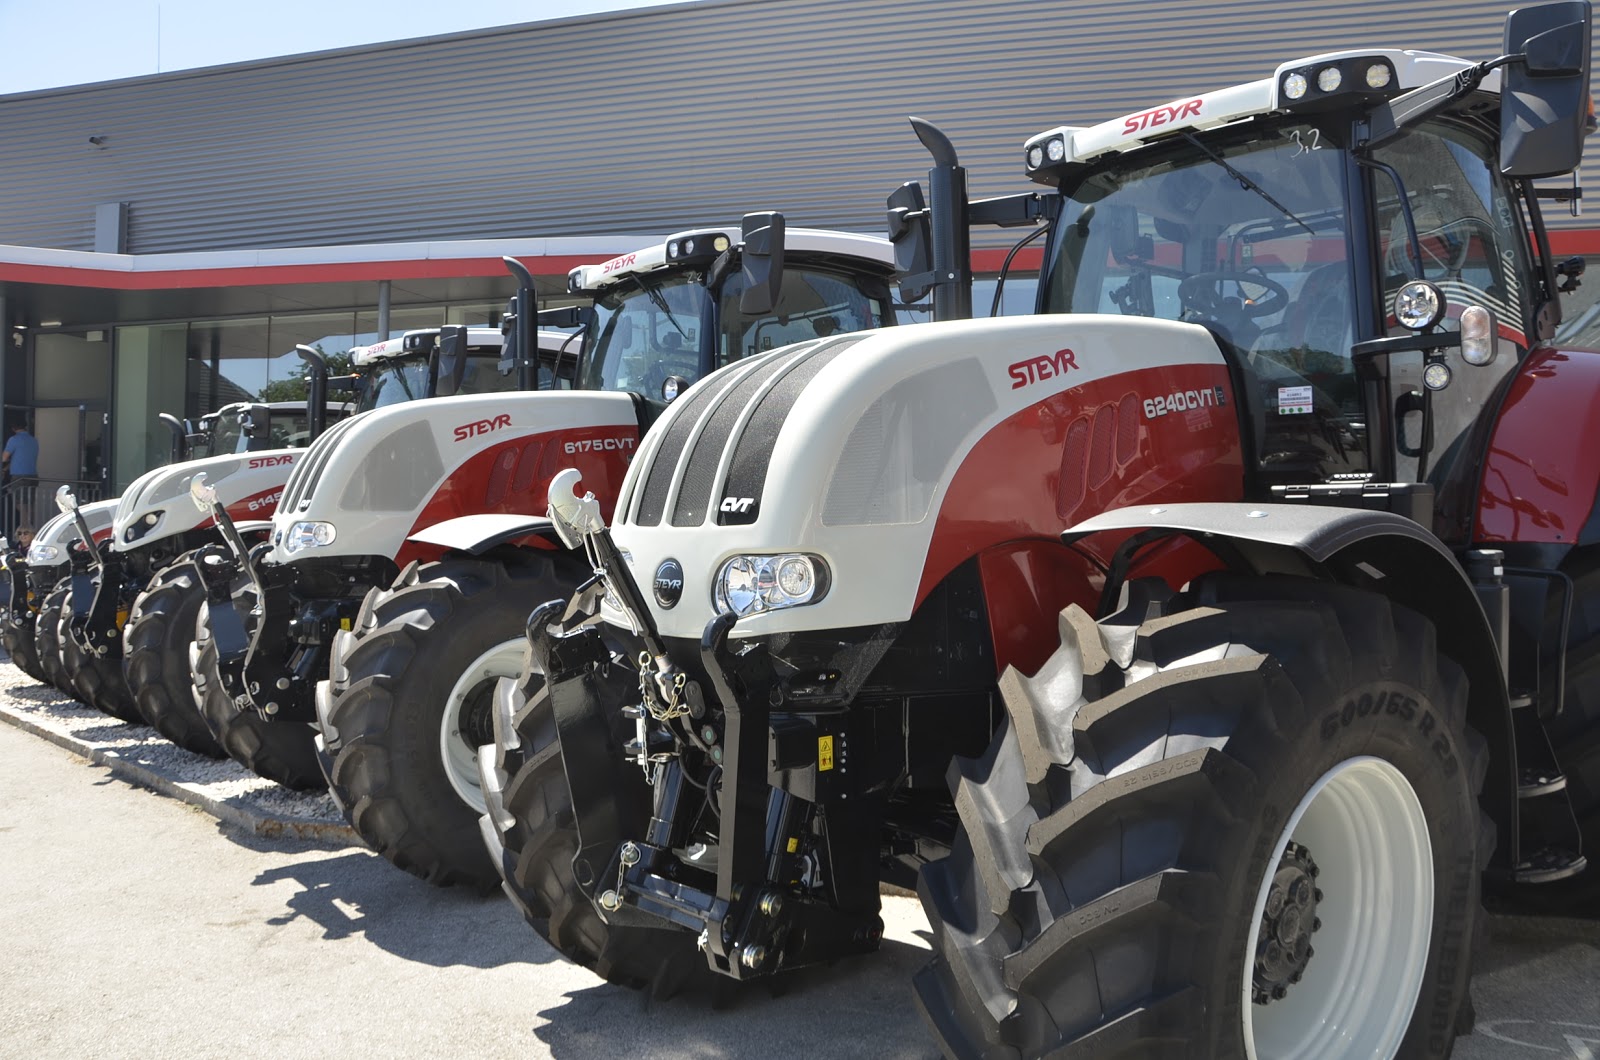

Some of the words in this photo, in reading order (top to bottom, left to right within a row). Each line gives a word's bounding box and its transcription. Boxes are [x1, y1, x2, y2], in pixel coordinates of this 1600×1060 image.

[1122, 99, 1203, 135] STEYR
[603, 254, 636, 274] STEYR
[1008, 348, 1080, 390] STEYR
[1143, 388, 1213, 419] 6240CVT
[453, 413, 513, 442] STEYR
[564, 438, 635, 454] 6175CVT
[248, 455, 293, 469] STEYR
[720, 497, 754, 513] CVT
[653, 578, 681, 589] STEYR
[1319, 691, 1419, 741] 600/65
